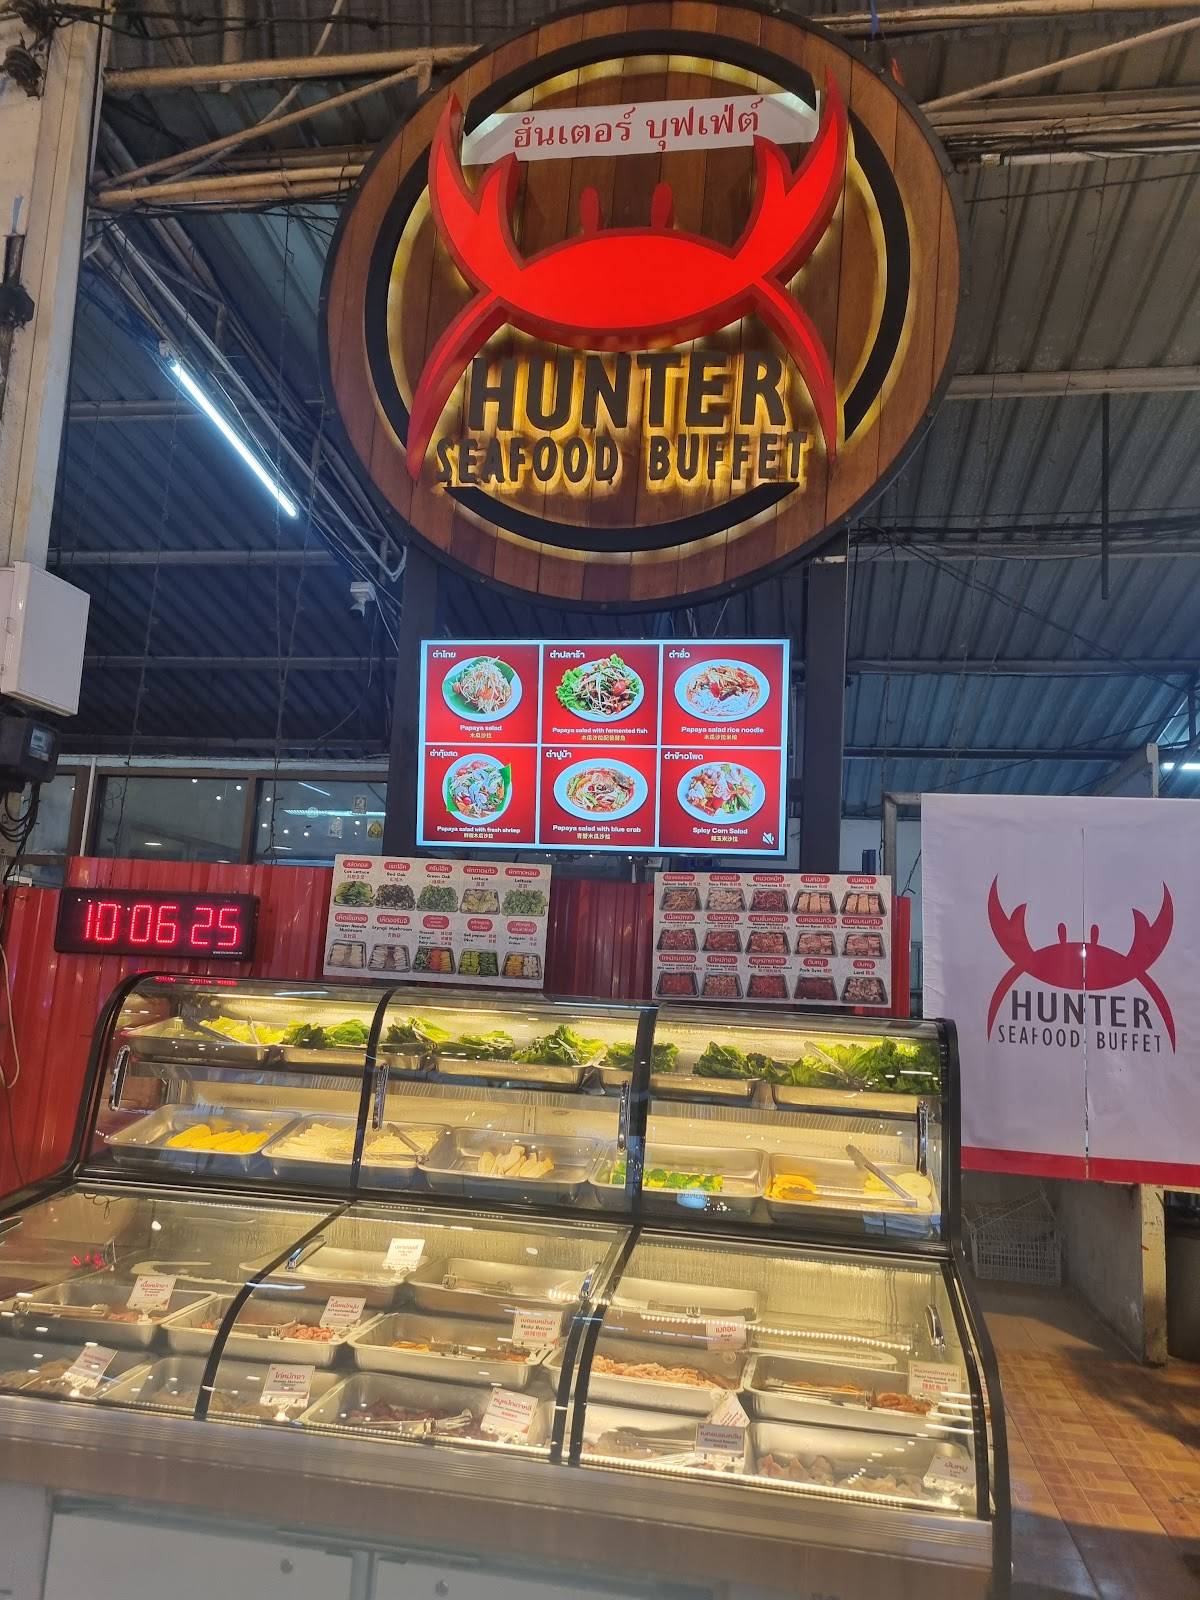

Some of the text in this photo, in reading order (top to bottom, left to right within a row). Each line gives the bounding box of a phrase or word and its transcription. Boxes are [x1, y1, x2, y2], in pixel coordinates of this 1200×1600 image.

[513, 98, 765, 150] ฮันเตอร์ บุฟเฟ่ต์
[467, 352, 787, 432] HUNTER
[436, 432, 810, 485] SEAFOOD BUFFET
[432, 650, 456, 659] ตำไทย
[550, 650, 585, 659] ตำปลาร้า
[459, 724, 484, 732] Papaya
[546, 750, 572, 760] ตำปูม้า
[664, 751, 704, 760] ตำข้าวโพด
[692, 827, 711, 835] Spicy
[85, 902, 238, 946] 10 06 25
[1011, 990, 1153, 1029] HUNTER
[998, 1025, 1161, 1053] SEAFOOD BUFFET
